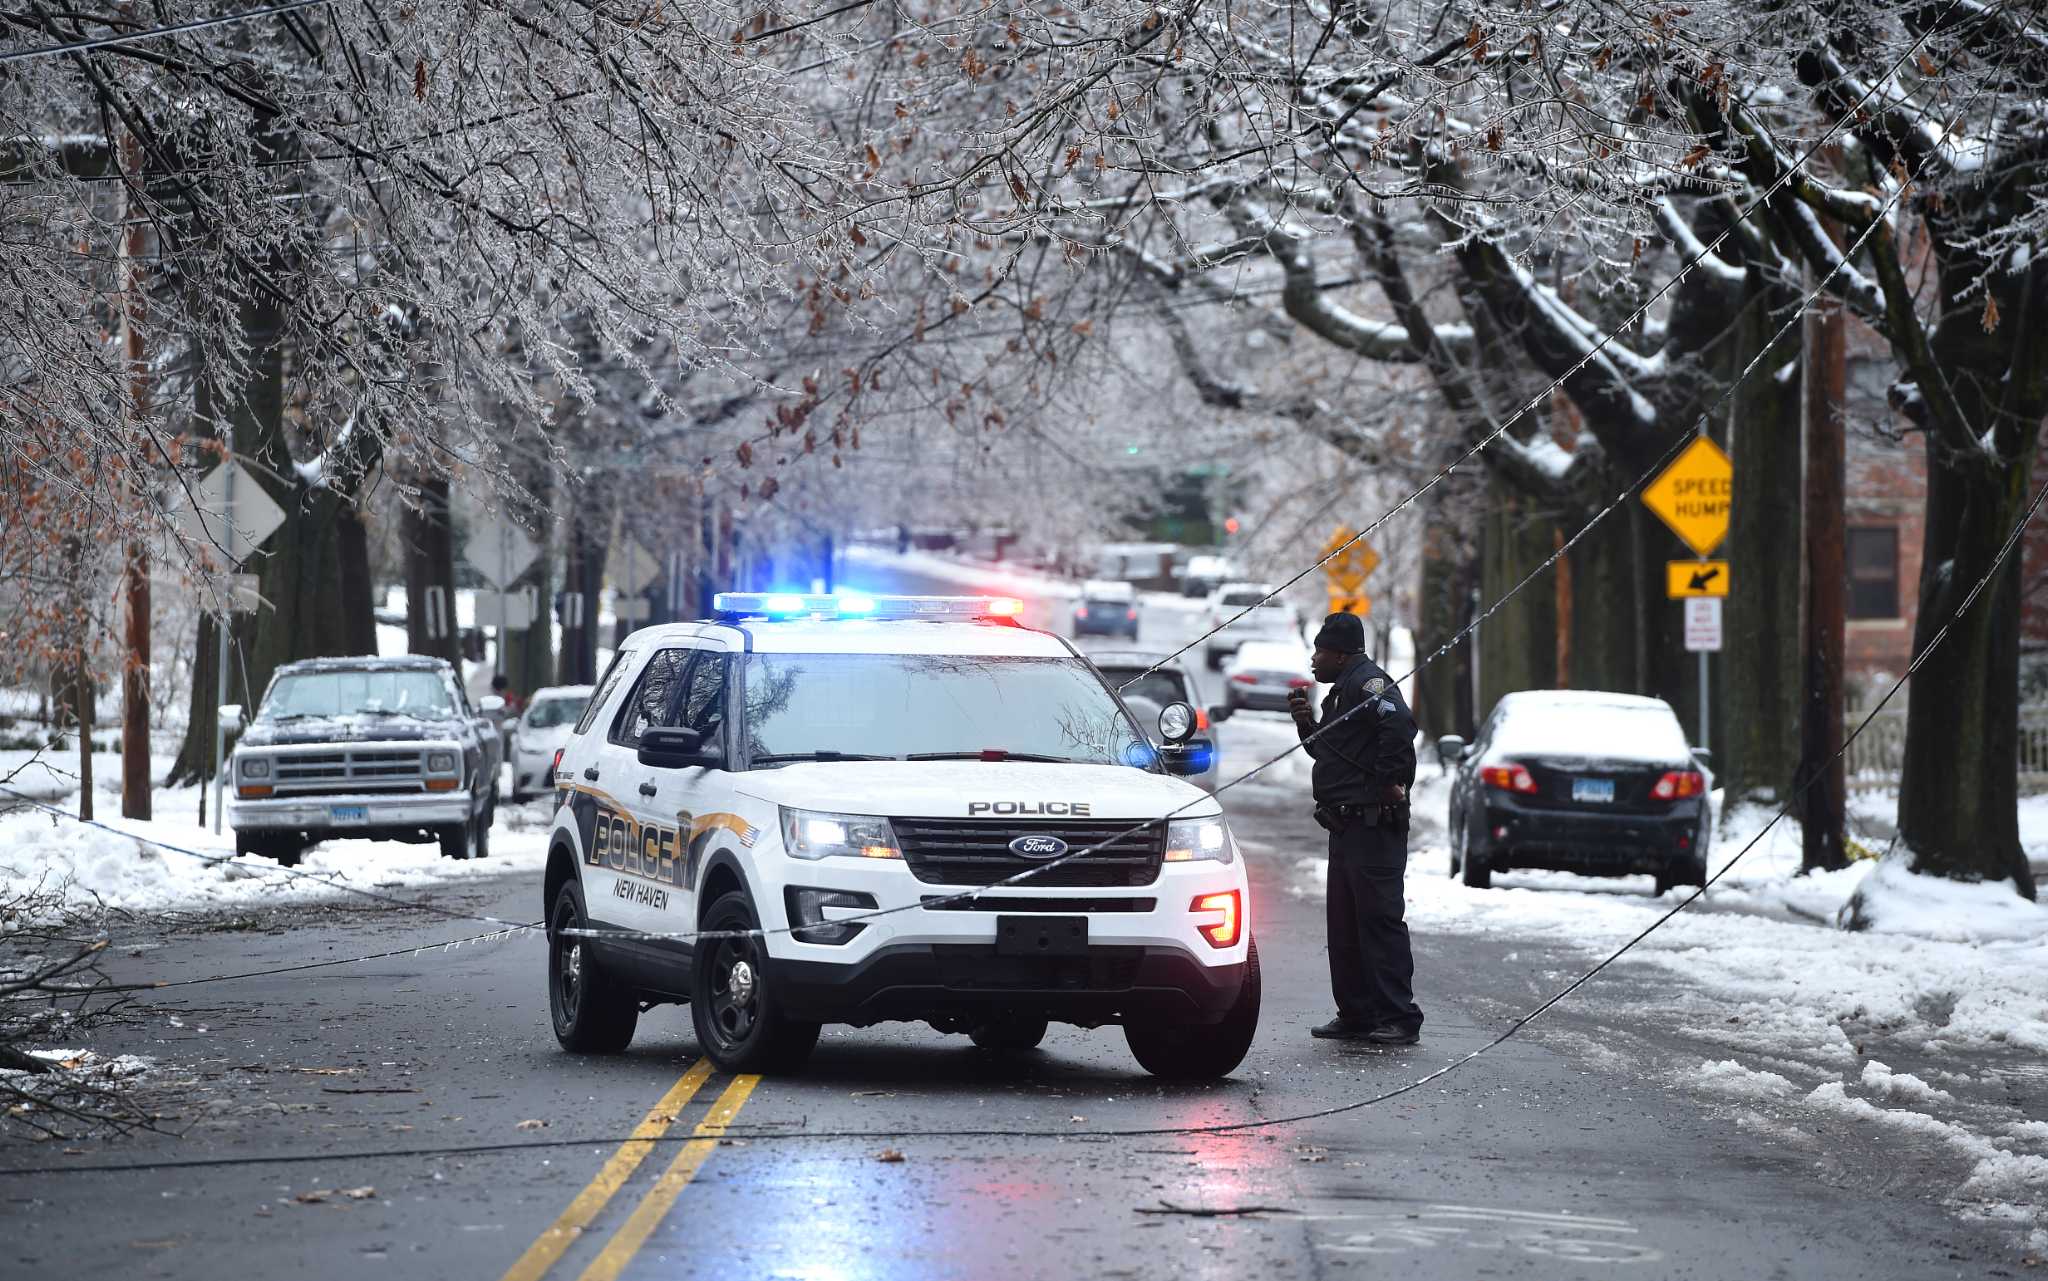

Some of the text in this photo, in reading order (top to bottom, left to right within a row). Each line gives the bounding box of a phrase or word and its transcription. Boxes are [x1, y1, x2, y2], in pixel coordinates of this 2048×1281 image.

[1674, 478, 1731, 495] SPEED
[1675, 501, 1730, 517] HUMP
[969, 802, 1090, 816] POLICE
[590, 811, 675, 883] POLICE
[1023, 838, 1056, 852] Ford
[613, 878, 669, 911] NEW HAVEN
